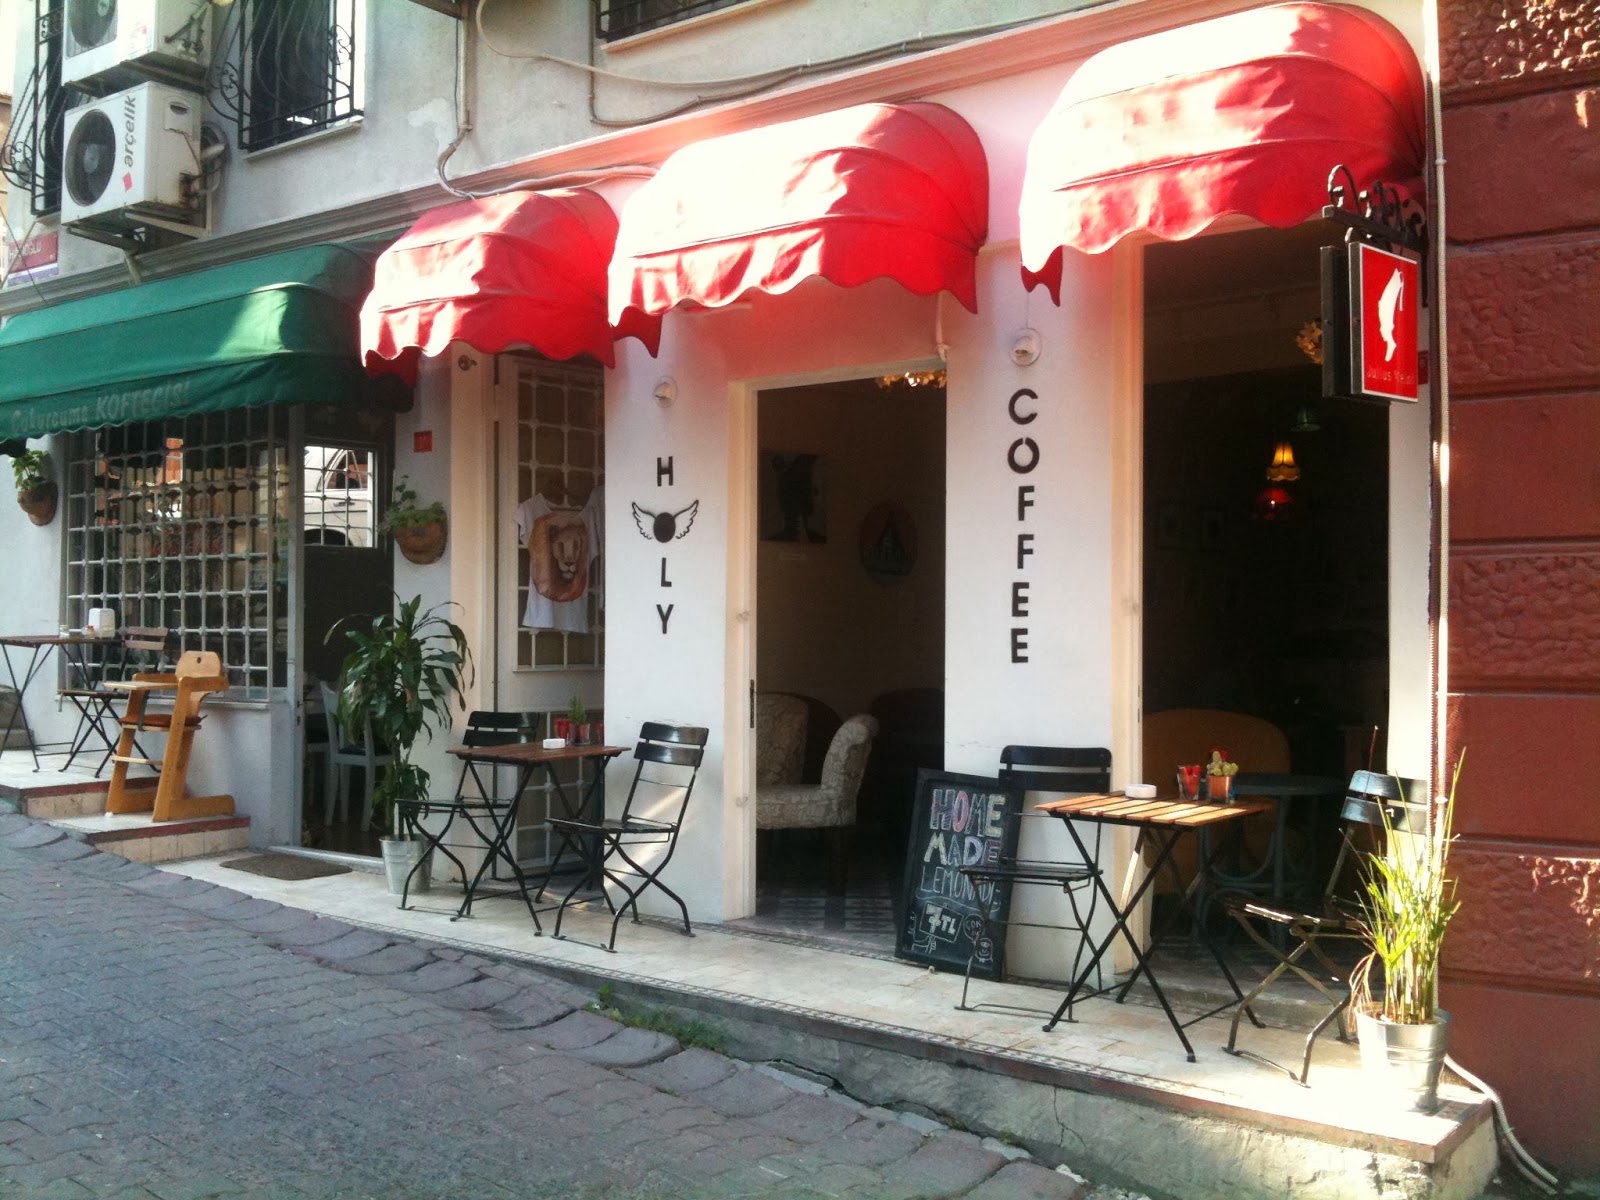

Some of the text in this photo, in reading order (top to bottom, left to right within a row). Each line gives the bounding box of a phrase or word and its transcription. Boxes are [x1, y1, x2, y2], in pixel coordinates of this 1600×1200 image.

[124, 95, 136, 168] arçelik
[1007, 388, 1040, 663] COFFEE
[930, 789, 1006, 838] HOME
[924, 831, 1002, 867] MADE
